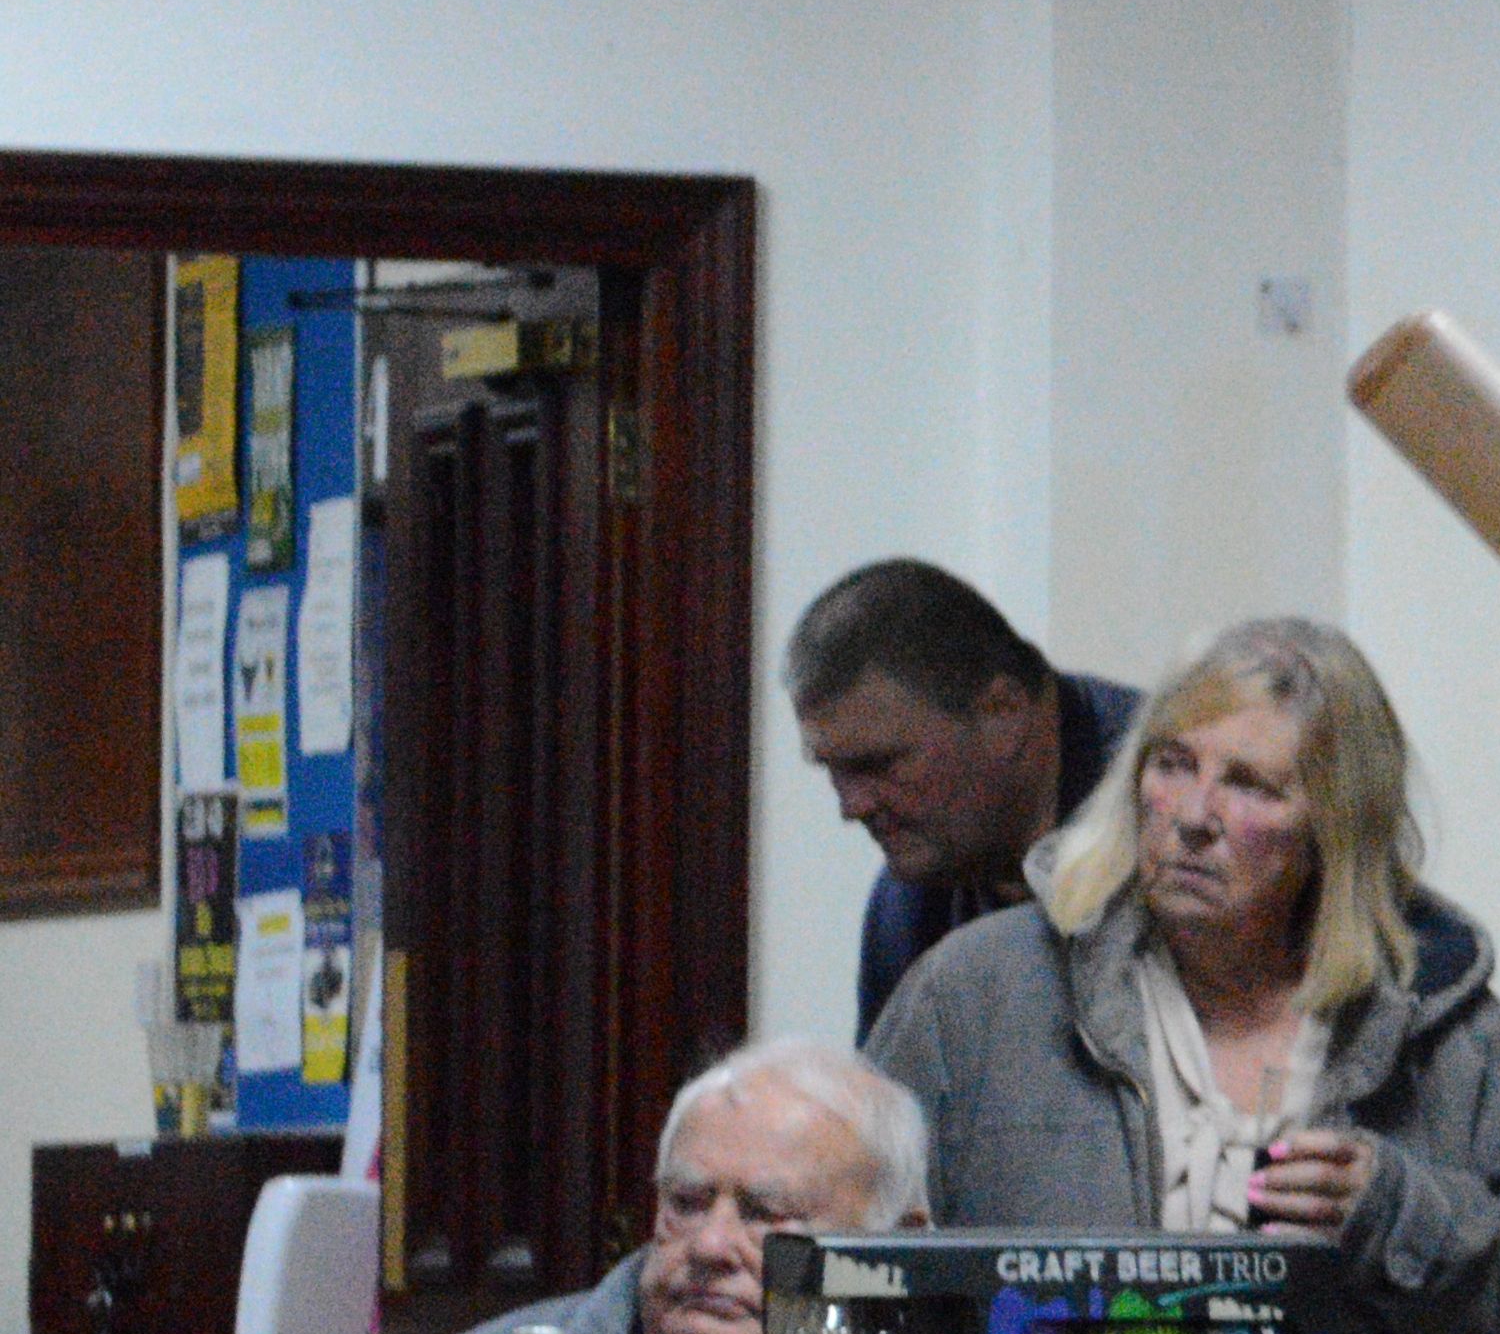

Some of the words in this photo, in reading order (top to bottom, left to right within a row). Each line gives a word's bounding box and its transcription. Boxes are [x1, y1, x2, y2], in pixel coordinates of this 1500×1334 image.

[996, 1250, 1105, 1283] CRAFT
[1116, 1249, 1204, 1283] BEER
[1207, 1250, 1289, 1283] TRIO
